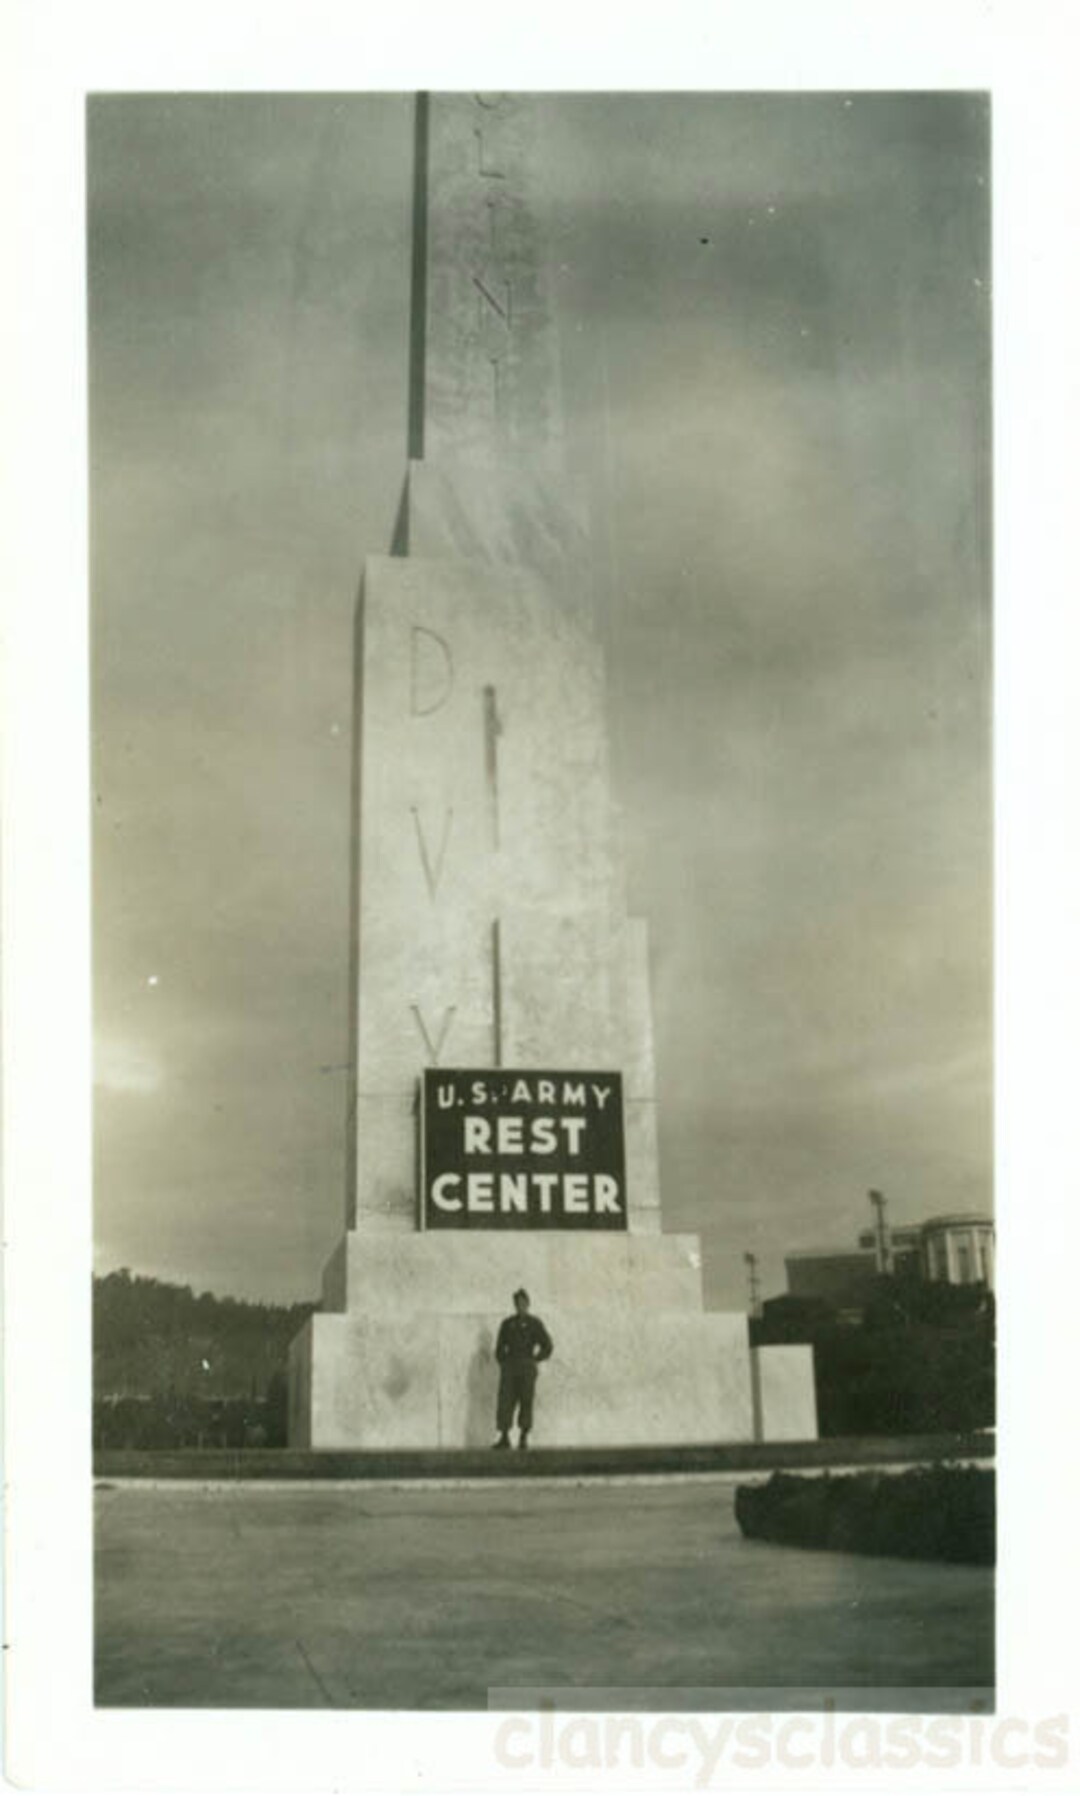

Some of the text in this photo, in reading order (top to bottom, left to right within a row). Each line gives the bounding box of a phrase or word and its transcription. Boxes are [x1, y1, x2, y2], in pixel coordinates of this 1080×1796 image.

[437, 1079, 611, 1109] U.S. ARMY
[463, 1116, 586, 1155] REST
[431, 1172, 622, 1213] CENTER
